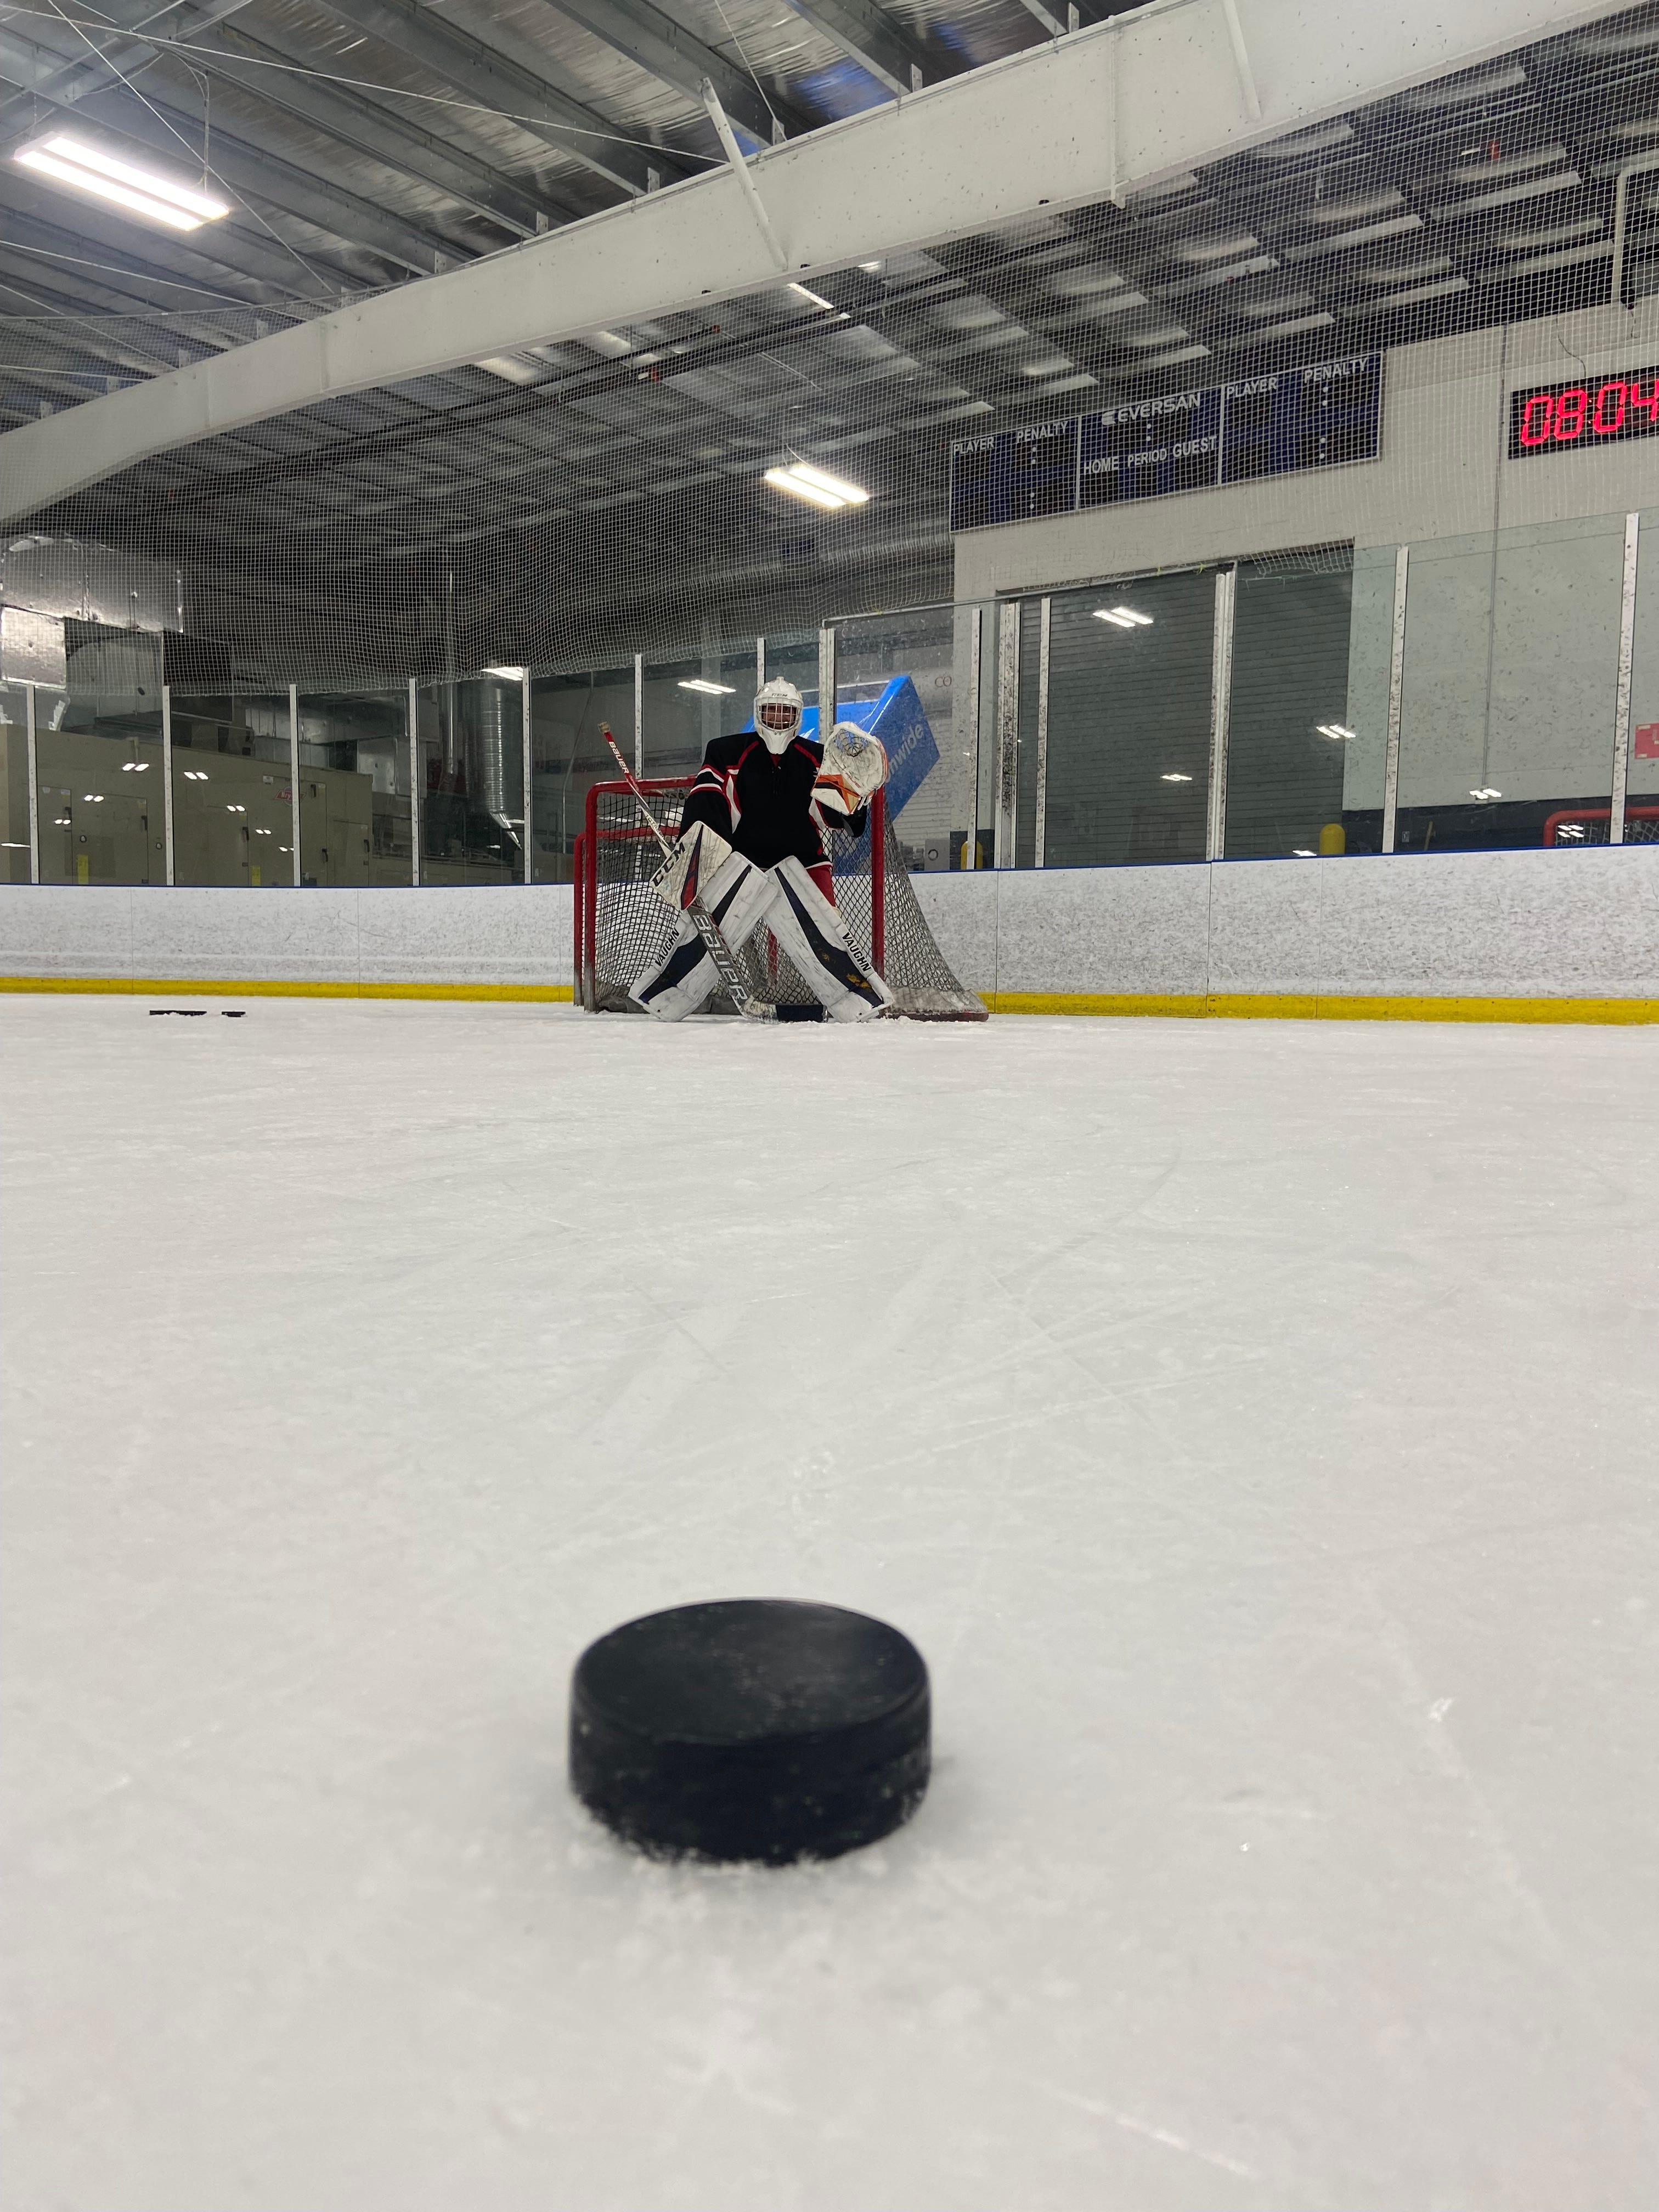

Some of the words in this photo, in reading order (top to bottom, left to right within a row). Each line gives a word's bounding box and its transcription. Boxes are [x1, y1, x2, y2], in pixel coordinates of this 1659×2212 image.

[1227, 377, 1277, 399] PLAYER
[1304, 358, 1368, 383] PENALTY
[1118, 392, 1200, 422] EVERSAN
[953, 437, 994, 456] PLAYER
[1017, 421, 1068, 444] PENALTY
[1084, 455, 1119, 475] HOME
[1127, 448, 1167, 467] PERIOD
[1172, 436, 1217, 458] GUEST
[885, 724, 924, 783] nwide
[651, 842, 686, 887] CCM
[655, 927, 680, 967] VAUGHN
[842, 932, 871, 972] VAUGHN
